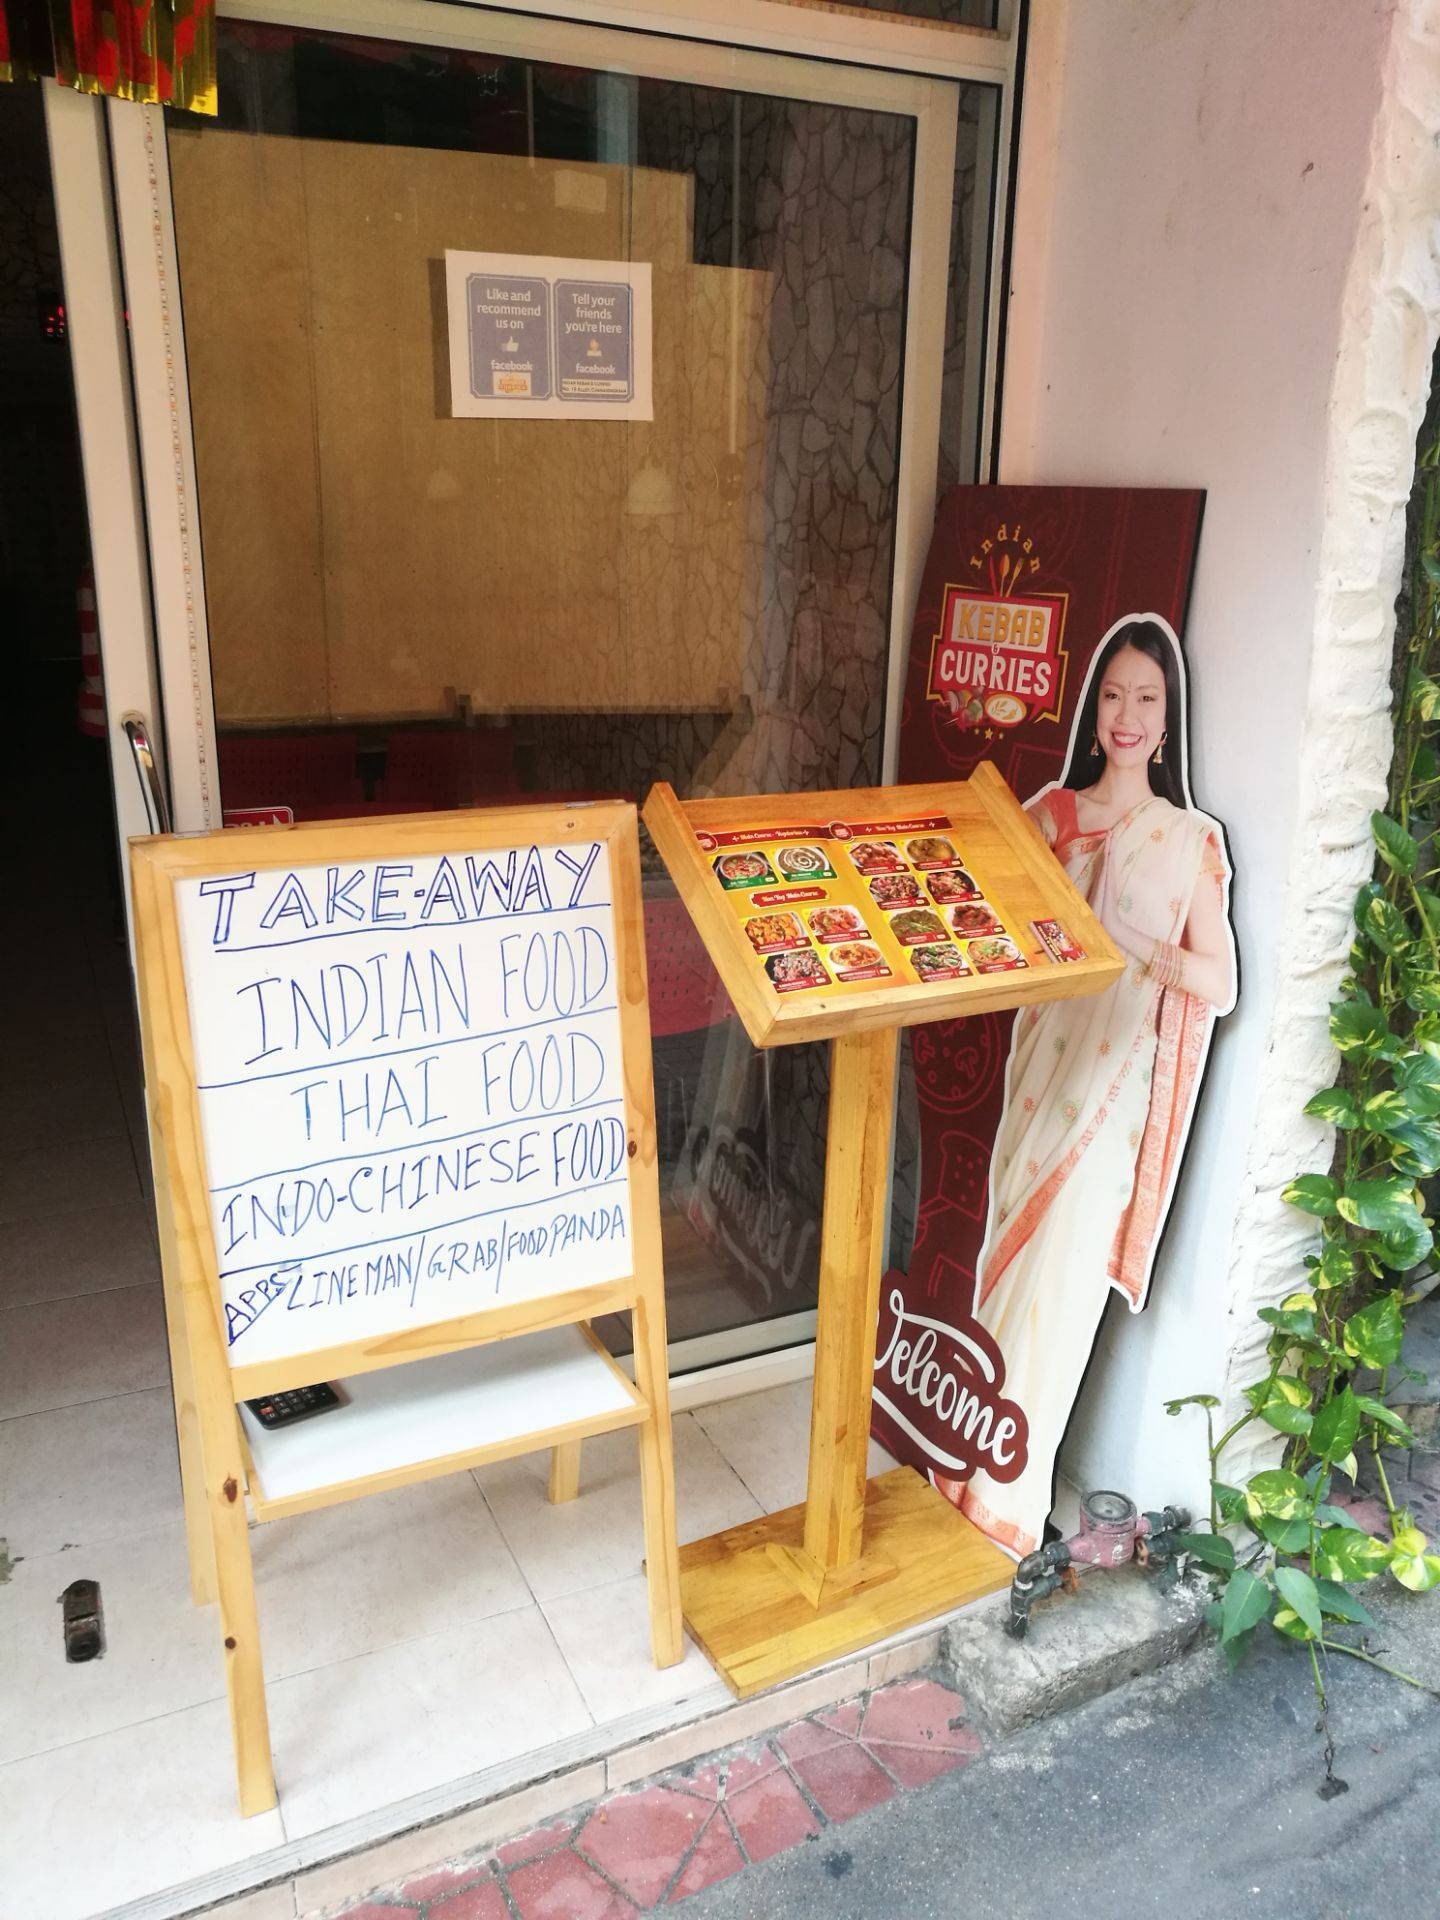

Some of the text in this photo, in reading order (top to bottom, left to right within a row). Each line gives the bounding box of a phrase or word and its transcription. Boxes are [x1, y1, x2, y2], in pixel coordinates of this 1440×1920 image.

[486, 288, 531, 302] Like and
[572, 294, 616, 307] Tell your
[477, 304, 541, 317] recommend
[576, 307, 612, 319] friends
[496, 320, 524, 329] us on
[565, 322, 622, 334] you're here
[491, 360, 533, 371] facebook
[576, 363, 616, 374] facebook
[970, 524, 1041, 574] Indian
[957, 602, 1047, 647] KEBAB
[992, 642, 1000, 654] &
[941, 649, 1051, 697] CURRIES
[200, 843, 602, 945] TAKE-AWAY
[237, 926, 608, 1066] INDIAN FOOD
[290, 1032, 604, 1141] THAI FOOD
[222, 1117, 626, 1255] INDO-CHINESE FOOD
